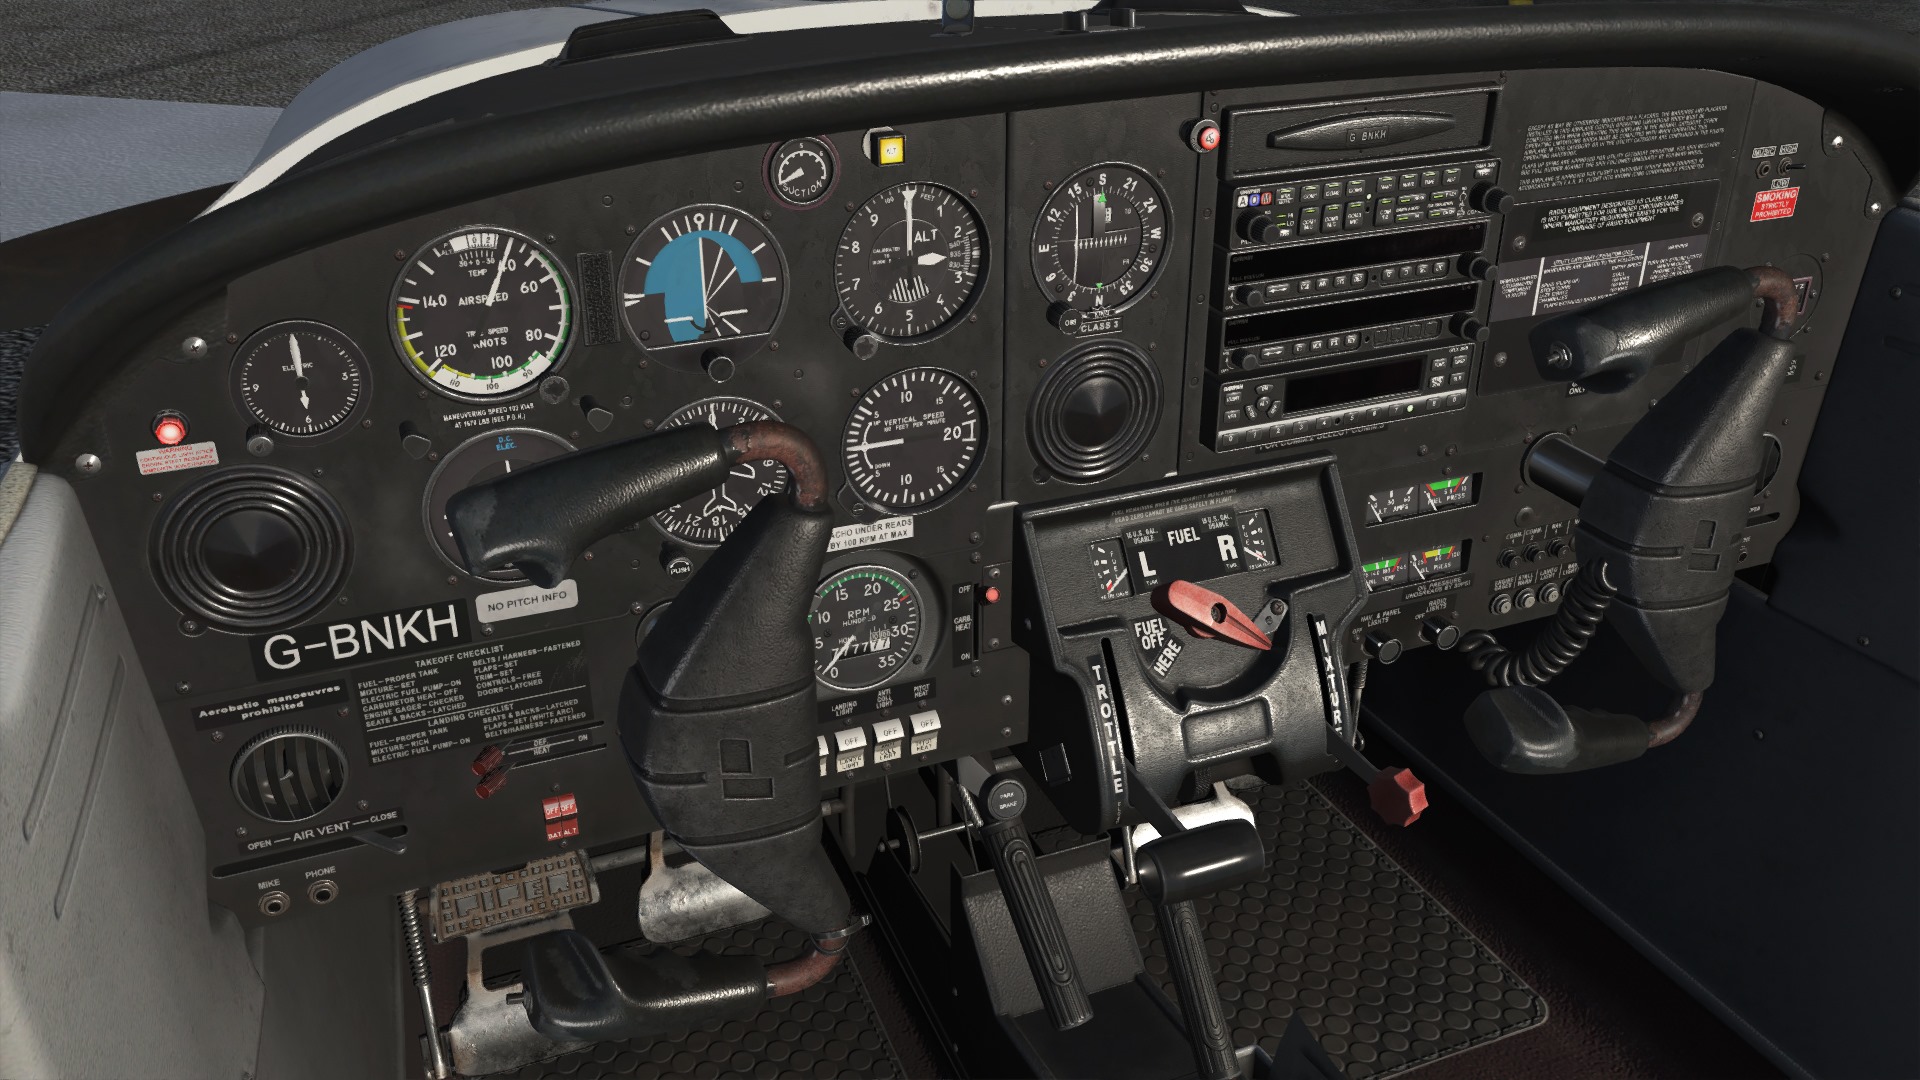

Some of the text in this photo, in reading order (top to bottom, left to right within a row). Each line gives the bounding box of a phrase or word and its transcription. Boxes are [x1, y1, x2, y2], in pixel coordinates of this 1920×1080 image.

[1350, 130, 1386, 142] G BNKH
[1098, 173, 1106, 186] S
[1122, 177, 1138, 192] 21
[782, 179, 823, 198] SUCTION
[1067, 182, 1082, 199] 15
[1756, 190, 1798, 203] SMOKING
[937, 205, 944, 218] 1
[1142, 197, 1158, 214] 24
[1760, 201, 1790, 210] STRICTLY
[1046, 208, 1062, 223] 12
[1755, 208, 1792, 218] PROHIBITED
[870, 214, 879, 226] 9
[914, 228, 938, 244] ALT
[954, 226, 962, 238] 2
[1150, 226, 1162, 240] W
[852, 240, 860, 254] 8
[1038, 243, 1050, 254] E
[468, 269, 488, 277] TEMP
[954, 271, 963, 284] 3
[520, 280, 538, 294] 60
[852, 278, 861, 290] 7
[422, 294, 448, 308] 140
[458, 292, 509, 307] AIRSPED
[936, 293, 944, 306] 4
[1095, 295, 1104, 306] N
[874, 302, 883, 314] 6
[906, 309, 914, 322] 5
[1081, 320, 1118, 332] CLASS 3
[526, 328, 542, 342] 80
[434, 344, 457, 358] 120
[491, 355, 513, 370] 100
[342, 372, 348, 380] 3
[252, 384, 260, 392] 9
[900, 390, 913, 404] 10
[936, 397, 944, 405] 15
[306, 415, 312, 424] 6
[874, 411, 880, 419] 5
[884, 411, 945, 426] VERTICAL SPEED
[943, 426, 962, 442] 20
[936, 466, 945, 474] 15
[900, 474, 913, 486] 10
[1188, 500, 1208, 510] SAFELY
[1216, 496, 1232, 504] FLIGHT
[1446, 493, 1466, 502] PRESS
[831, 518, 912, 539] ACHO UNDER READS
[844, 538, 856, 546] 100
[860, 535, 876, 544] RPM
[879, 532, 888, 540] AT
[890, 529, 908, 539] MAX
[1166, 526, 1200, 547] FUEL
[1216, 534, 1238, 562] R
[1137, 550, 1157, 578] L
[670, 565, 690, 576] PUSH
[864, 582, 882, 597] 20
[958, 584, 972, 594] OFF
[487, 590, 568, 613] NO PITCH INFO
[834, 590, 849, 602] 15
[884, 600, 901, 612] 25
[1428, 598, 1447, 607] RADIO
[817, 611, 831, 625] 10
[848, 607, 870, 620] RPM
[1382, 608, 1402, 618] PANEL
[890, 624, 909, 638] 30
[955, 622, 972, 632] HEAT
[1134, 618, 1168, 638] FUEL
[264, 604, 459, 670] G-BNKH
[814, 636, 824, 650] 5
[1141, 632, 1164, 650] OFF
[415, 644, 504, 668] TAKEOFF CHECKLIST
[472, 656, 496, 666] BELTS
[878, 654, 896, 669] 35
[960, 652, 971, 661] ON
[1153, 639, 1182, 676] HERE
[418, 668, 440, 678] TANK
[830, 666, 838, 678] 0
[878, 688, 891, 696] ANTI
[914, 684, 930, 692] PITOT
[914, 690, 929, 698] HEAT
[199, 685, 341, 718] Aerobatic manoeuvres
[361, 688, 420, 704] ELECTRIC FUEL
[241, 700, 304, 720] prohibited
[362, 696, 415, 712] CARBURETOR
[832, 700, 858, 712] LANDING
[876, 699, 894, 709] LIGHT
[364, 709, 394, 720] ENGINE
[428, 703, 514, 727] LANDING CHECKLIST
[836, 708, 854, 716] LIGHT
[366, 718, 390, 728] SEATS
[482, 714, 506, 724] SEATS
[920, 719, 935, 728] OFF
[428, 727, 448, 736] TANK
[884, 727, 898, 736] OFF
[1092, 664, 1123, 794] TROTTLE
[844, 736, 859, 746] OFF
[372, 746, 431, 763] ELECTRIC FUEL
[534, 746, 551, 756] HEAT
[1000, 792, 1014, 800] PARK
[546, 806, 558, 815] OFF
[561, 803, 574, 812] OFF
[1000, 801, 1018, 810] BRAKE
[248, 811, 398, 850] OPEN AIR VENT CLOSE
[548, 831, 562, 840] BAT
[304, 866, 336, 880] PHONE
[258, 878, 280, 890] MIKE
